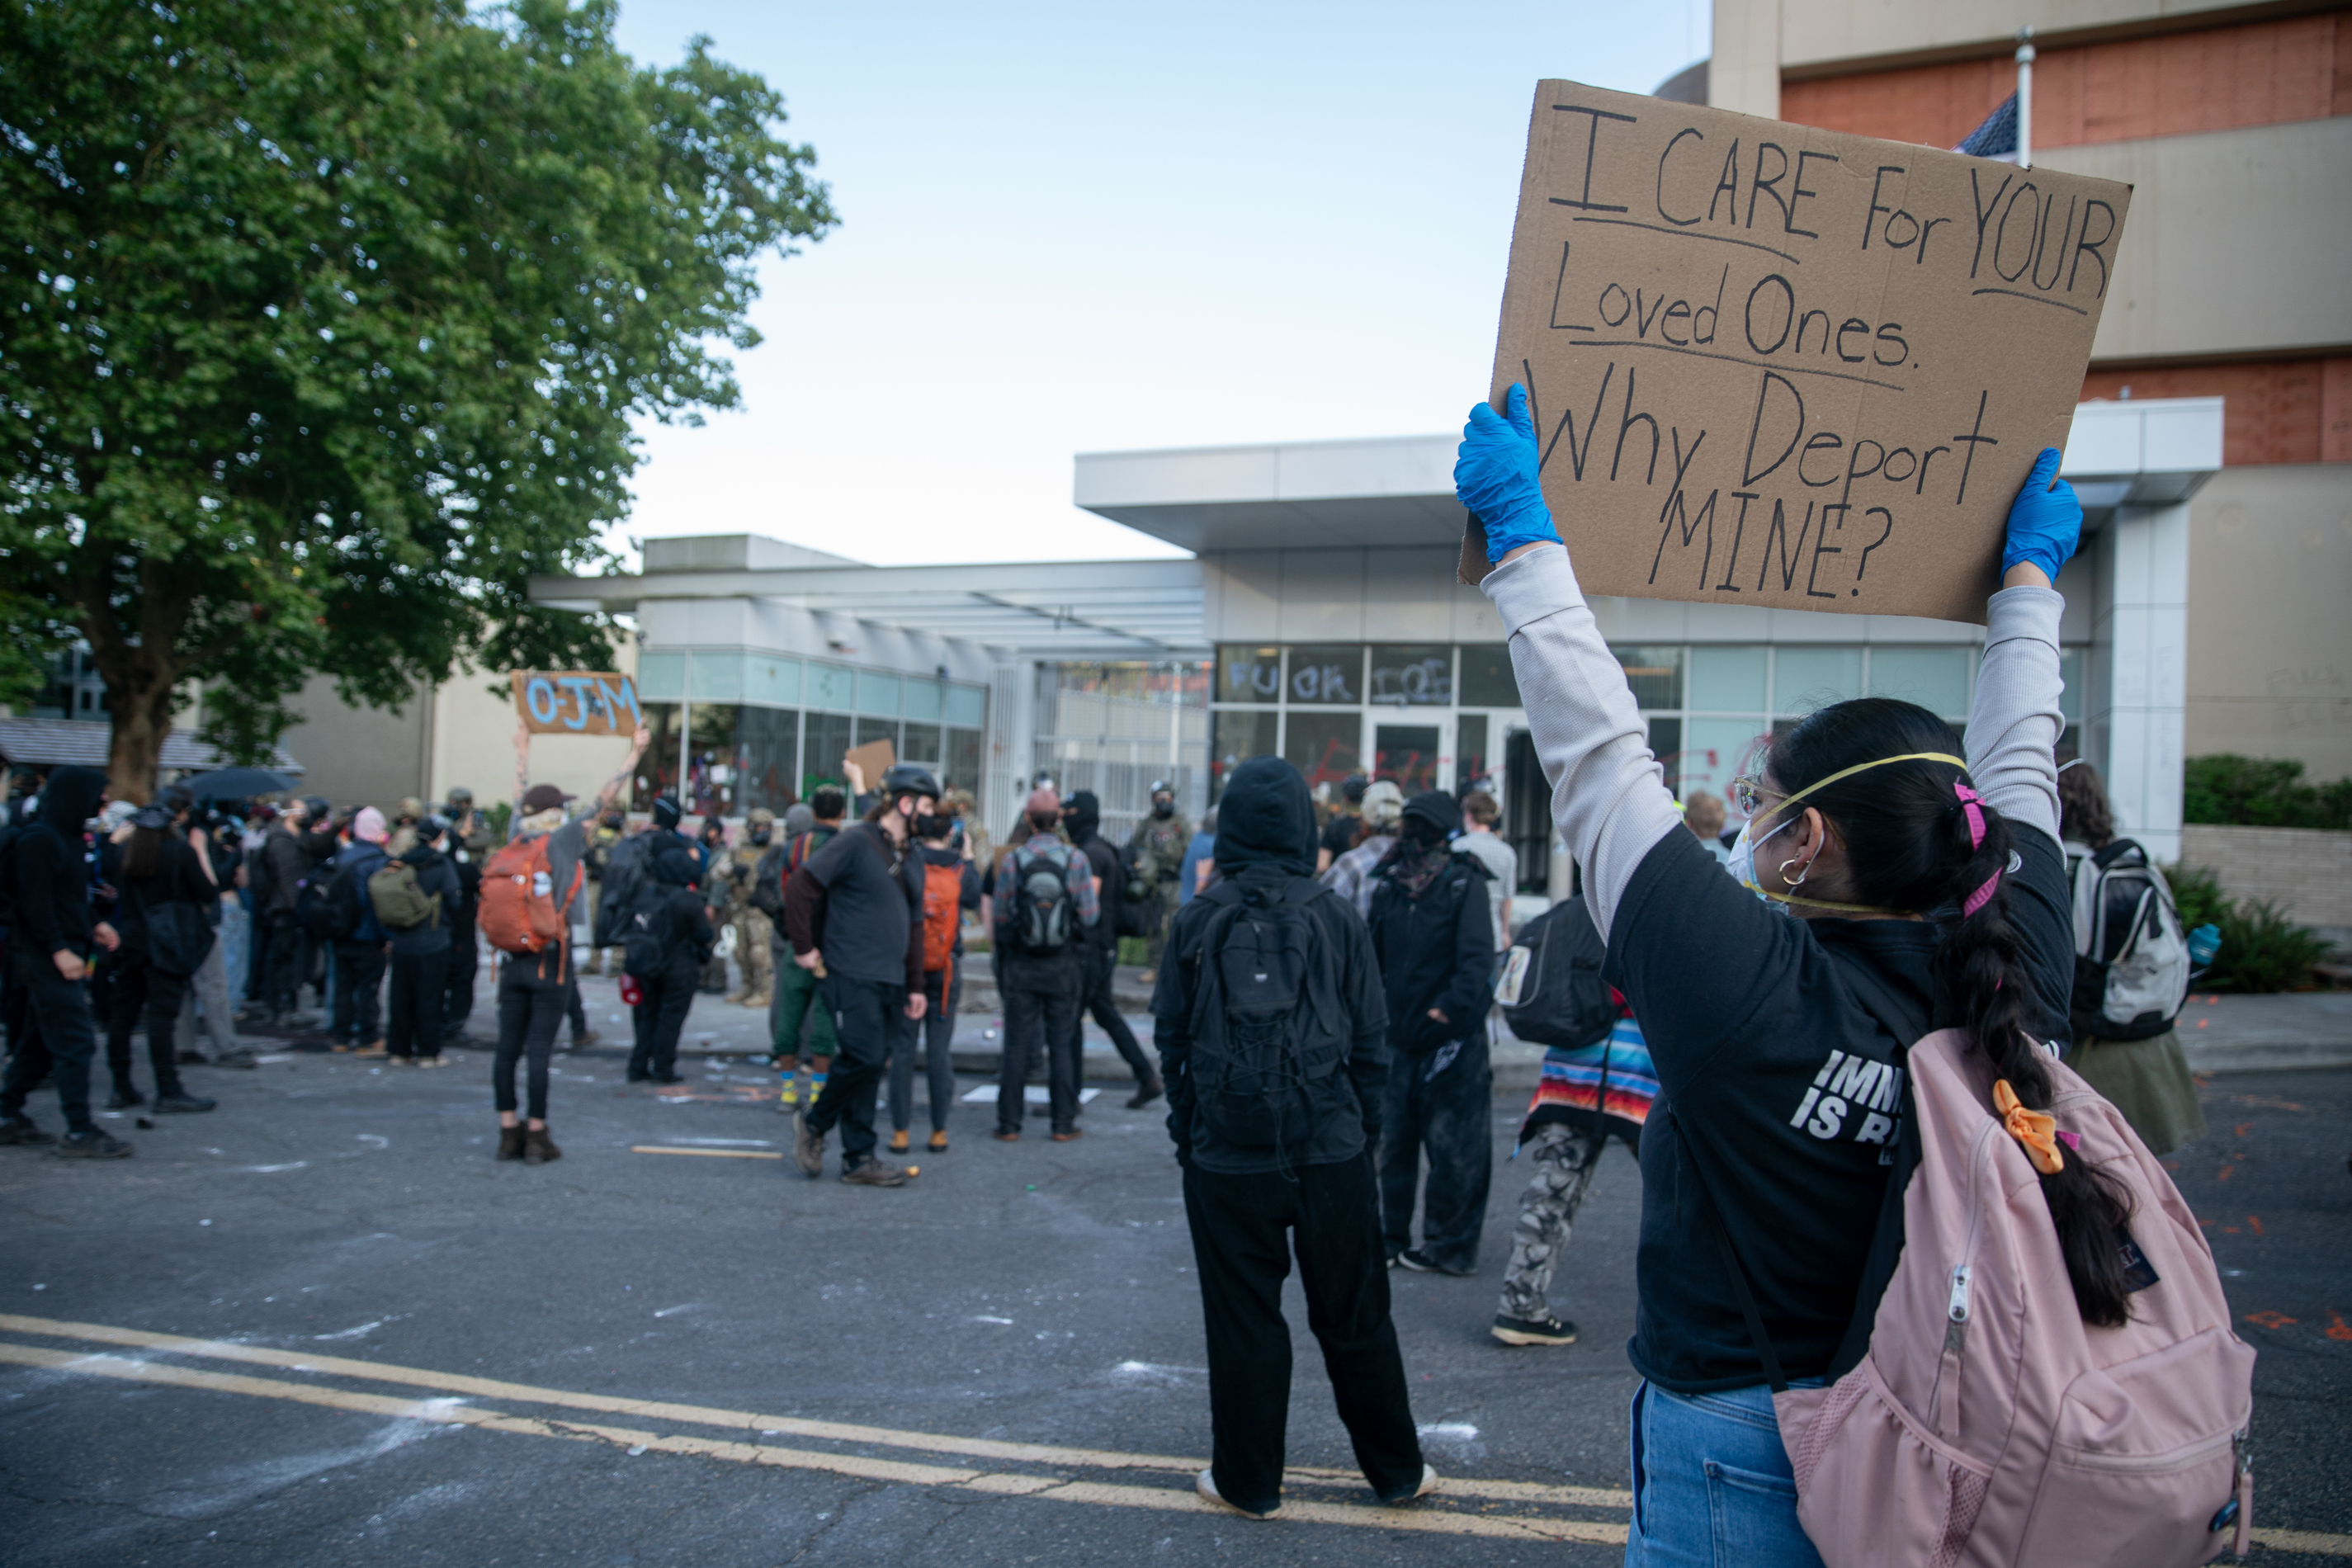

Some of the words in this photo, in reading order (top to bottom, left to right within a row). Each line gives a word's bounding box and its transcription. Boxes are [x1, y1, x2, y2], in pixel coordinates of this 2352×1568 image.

[1548, 103, 1636, 213] I
[1656, 127, 1839, 239] CARE
[1862, 166, 1951, 264] For
[1970, 168, 2117, 299] YOUR
[1549, 240, 1729, 345] Loved
[1745, 273, 1920, 370] Ones.
[1523, 359, 1707, 524] Why
[1742, 370, 1998, 530] Deport
[1649, 489, 1892, 599] MINE?
[1789, 1086, 1848, 1140] IS
[1813, 1049, 1904, 1114] IMM
